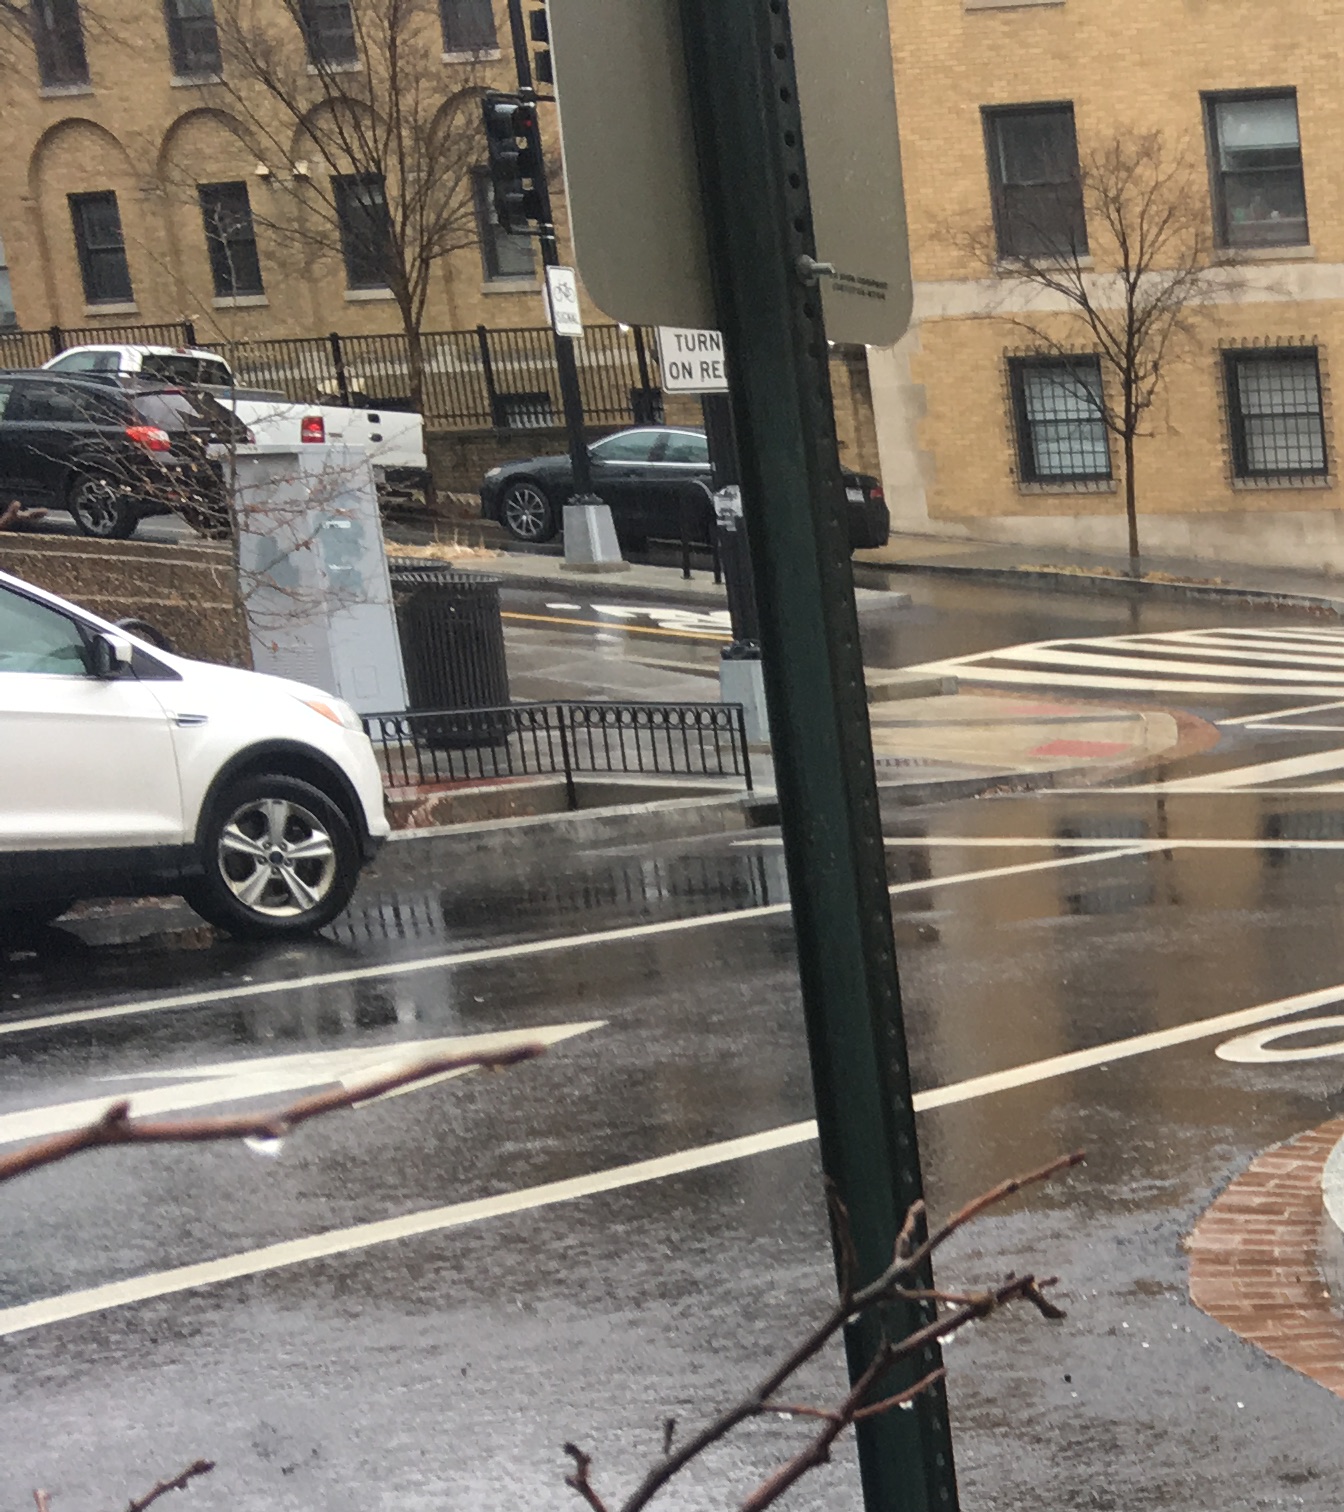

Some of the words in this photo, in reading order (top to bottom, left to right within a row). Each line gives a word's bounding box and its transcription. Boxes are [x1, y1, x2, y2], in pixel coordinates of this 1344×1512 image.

[673, 332, 721, 353] TURN
[668, 361, 694, 380] ON
[700, 360, 723, 379] RE
